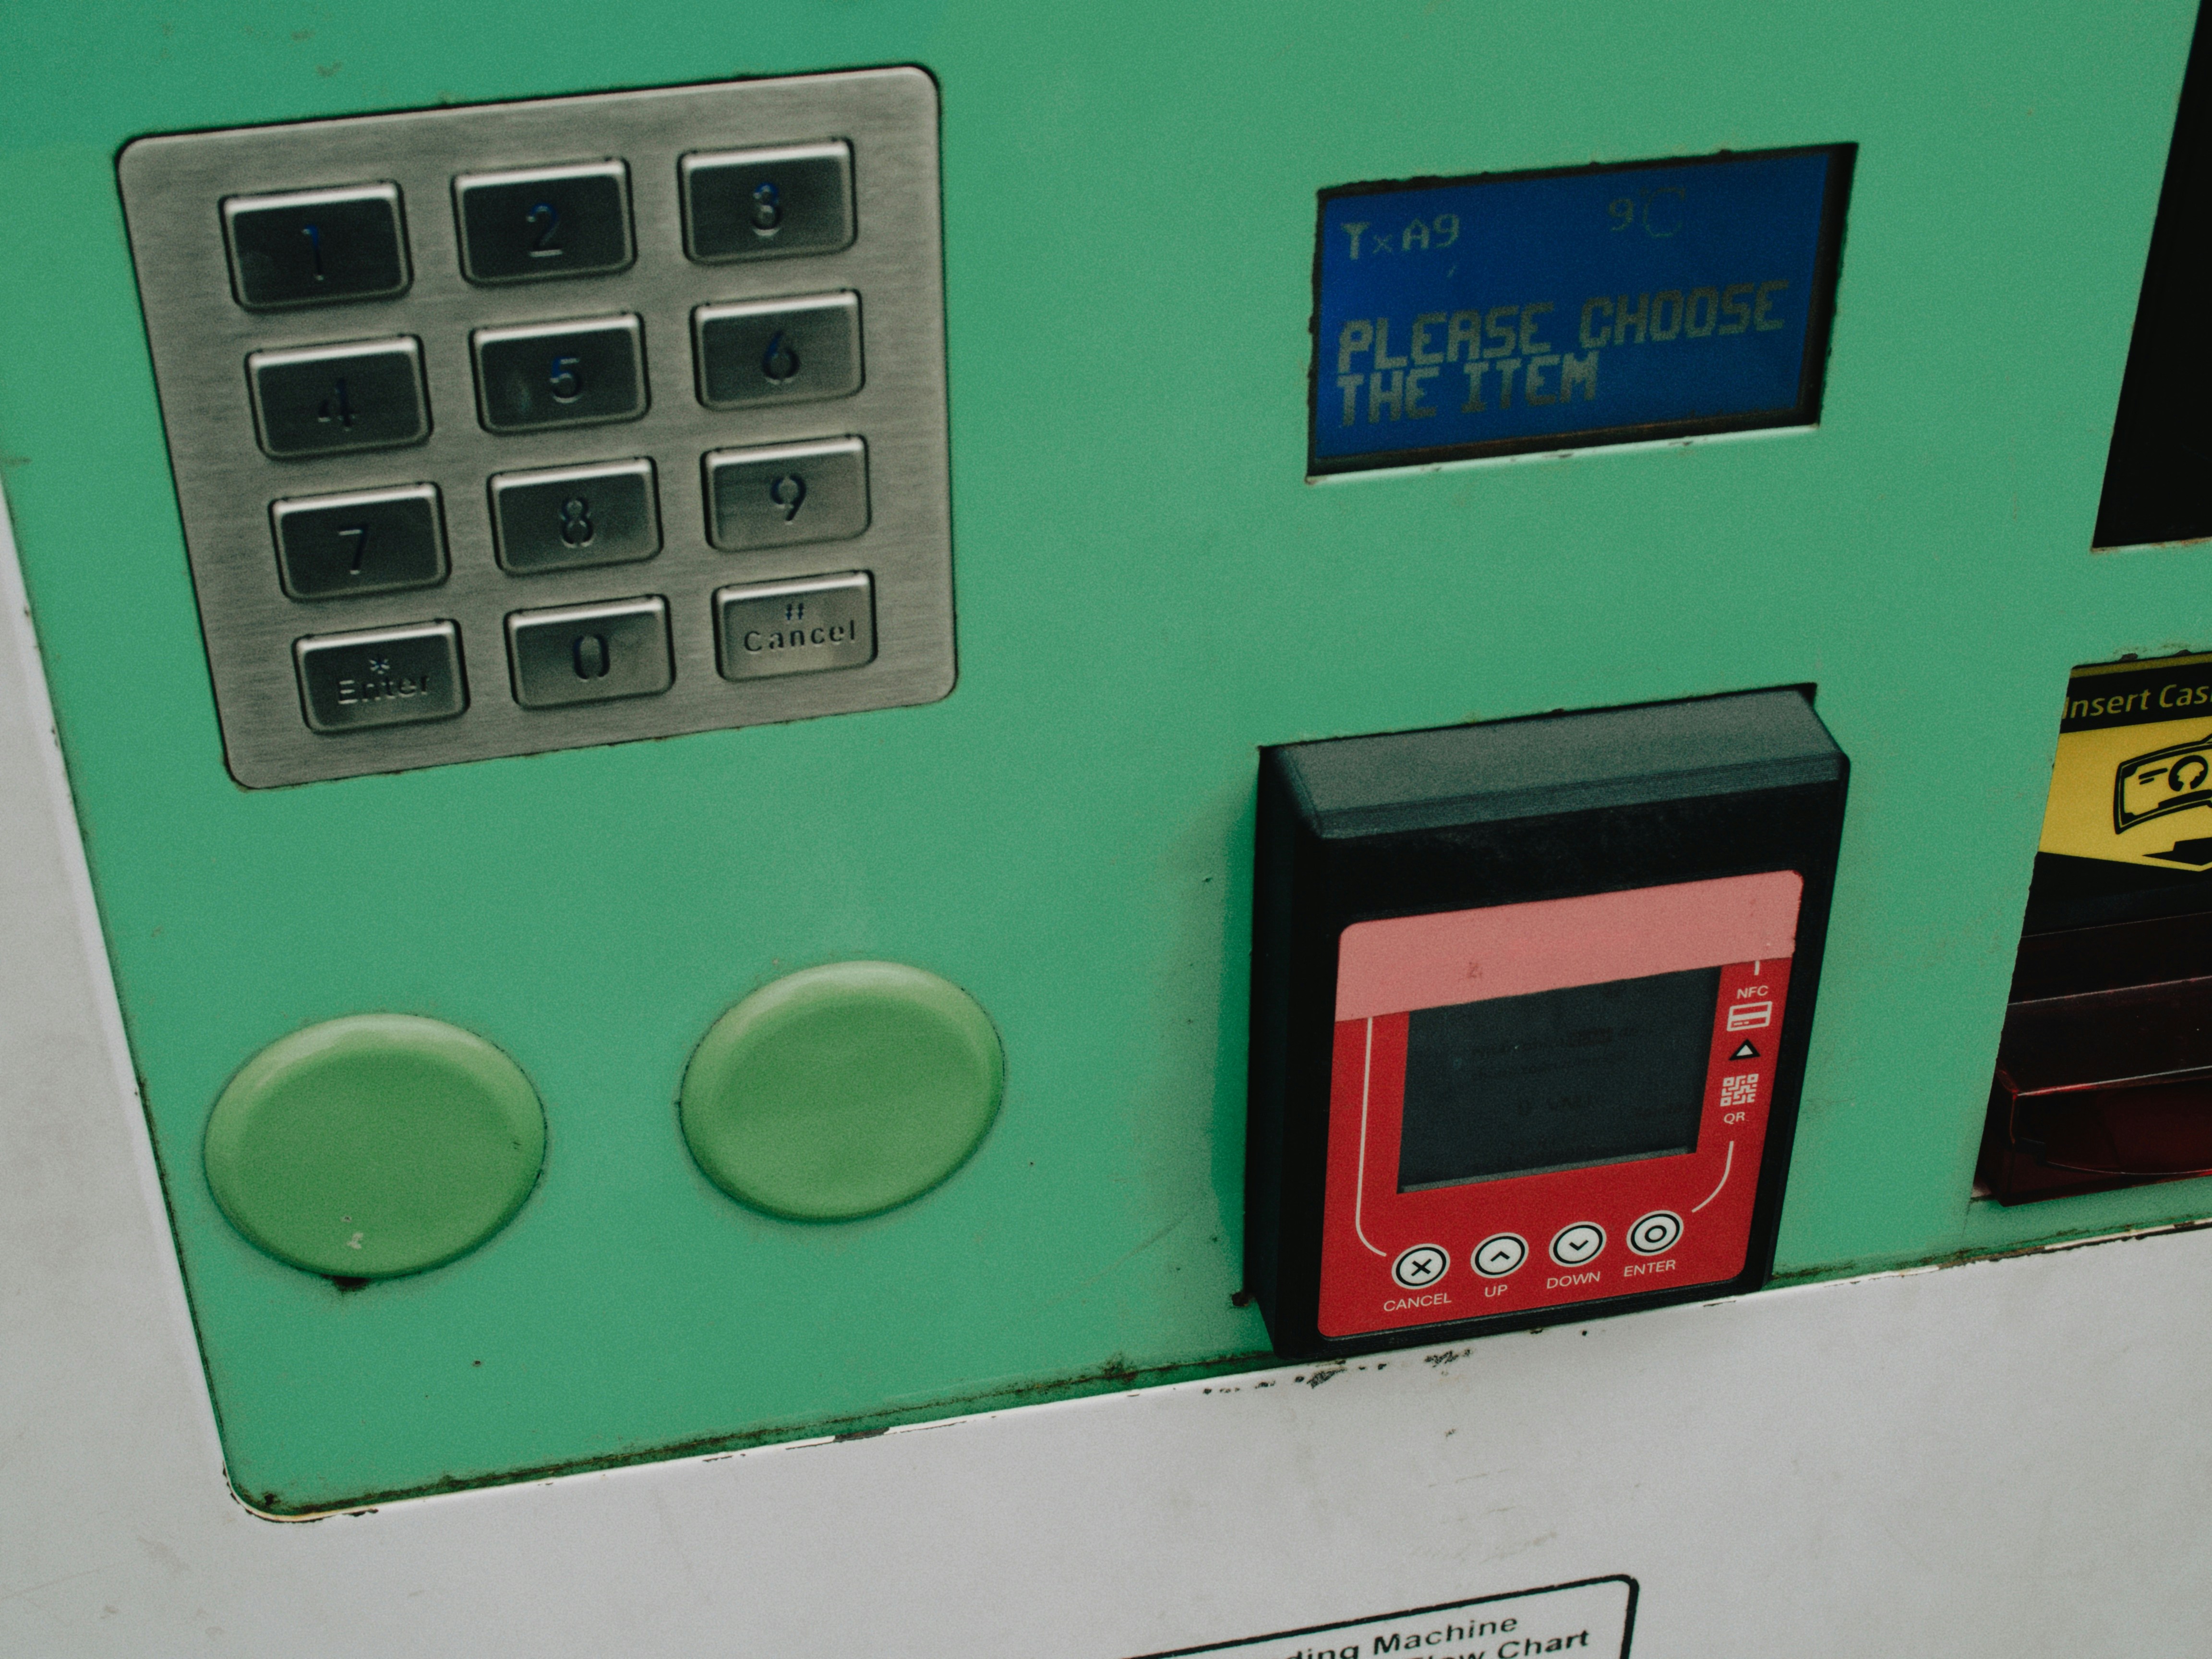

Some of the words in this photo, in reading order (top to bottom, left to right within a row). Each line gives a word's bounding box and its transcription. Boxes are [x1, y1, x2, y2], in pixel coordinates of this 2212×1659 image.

[526, 203, 563, 257] 2
[752, 182, 781, 237] 3
[302, 225, 324, 281] 1
[1338, 301, 1554, 374] PLEASE
[1579, 279, 1789, 349] CHOOSE
[550, 356, 581, 403] 5
[762, 329, 800, 385] 6
[317, 377, 357, 431] 4
[1337, 366, 1440, 427] THE
[1461, 350, 1599, 413] ITEM
[560, 495, 594, 548] 8
[770, 473, 807, 525] 9
[338, 523, 369, 575] 7
[573, 633, 611, 682] 0
[744, 620, 855, 654] Cancel
[338, 674, 430, 704] Enter
[2061, 689, 2151, 720] Insert
[2159, 684, 2212, 708] Cas
[1737, 985, 1769, 999] NFC
[1723, 1112, 1745, 1124] QR
[1484, 1284, 1508, 1298] UP
[1546, 1271, 1601, 1289] DOWN
[1623, 1259, 1676, 1277] ENTER
[1383, 1292, 1452, 1312] CANCEL
[1374, 1618, 1517, 1655] Machine
[1498, 1630, 1589, 1659] Chart
